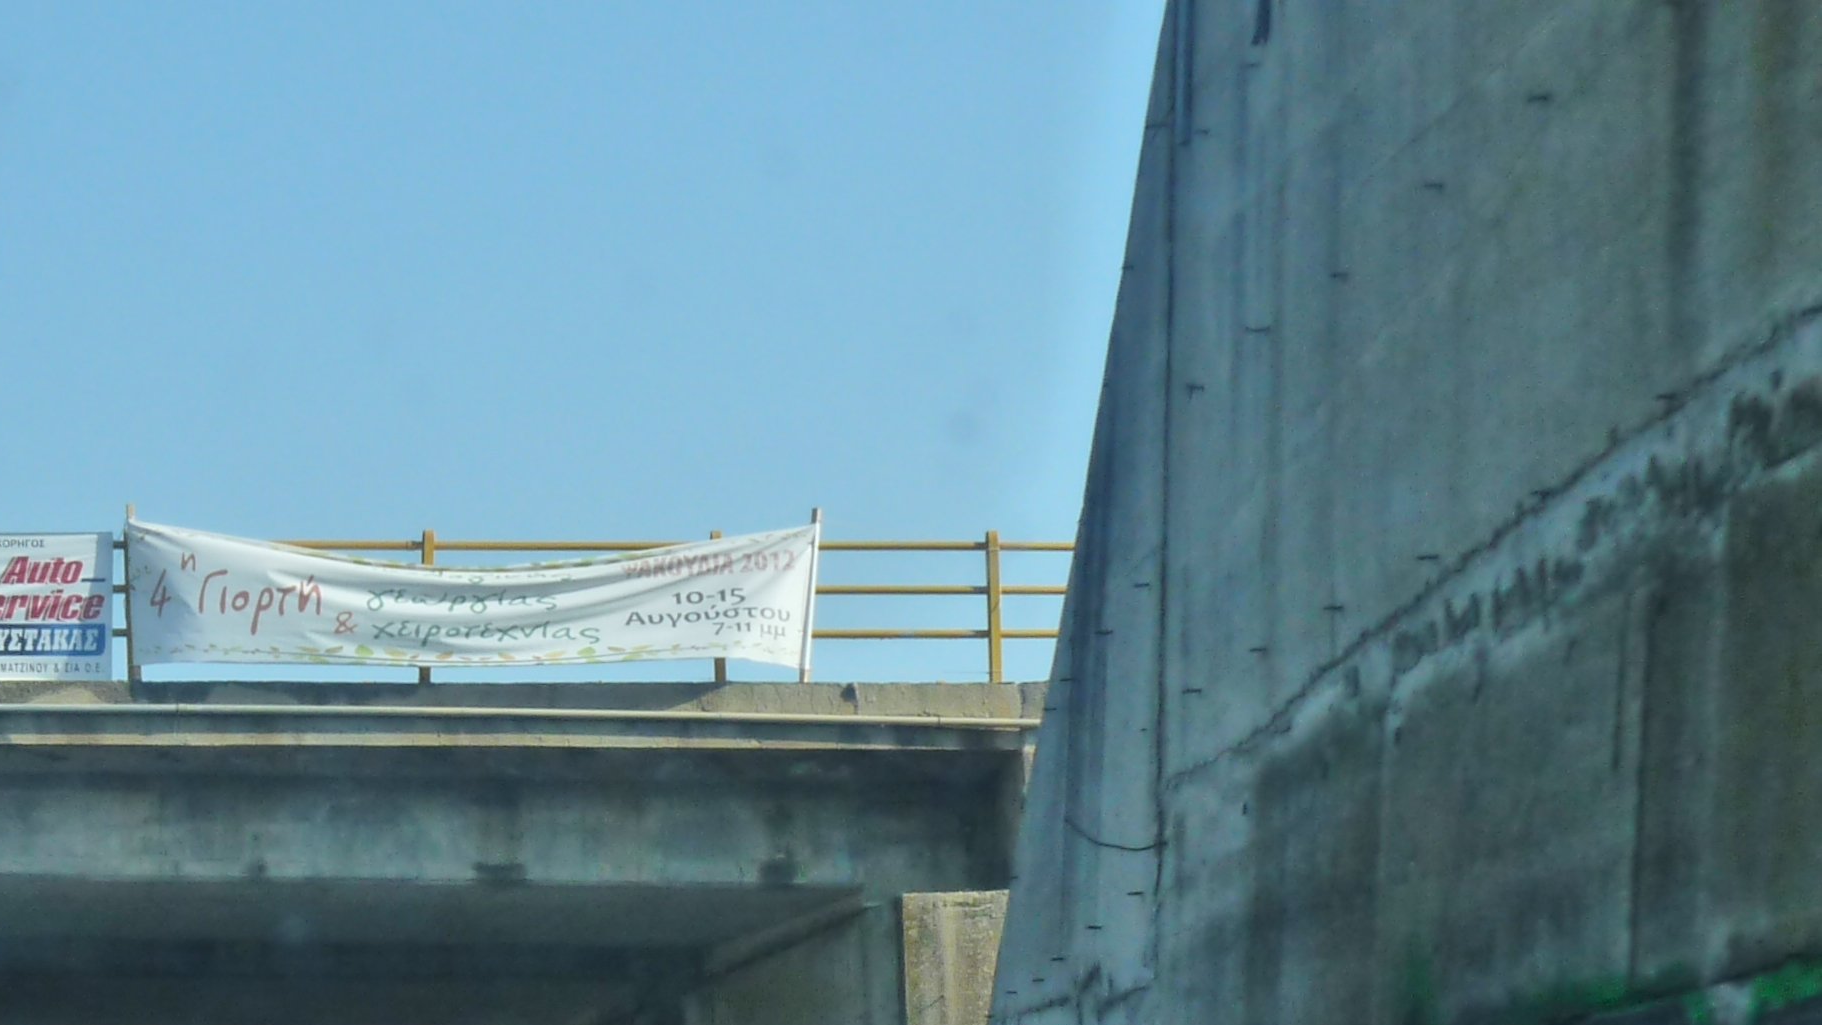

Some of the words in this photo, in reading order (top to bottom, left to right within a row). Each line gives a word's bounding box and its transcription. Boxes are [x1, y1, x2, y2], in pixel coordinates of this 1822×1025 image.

[740, 551, 796, 574] 2012
[199, 574, 322, 636] Γιορτή
[672, 588, 747, 605] 10-15
[334, 611, 358, 635] &
[625, 605, 791, 628] Αυγούστου
[712, 621, 752, 636] 7-11
